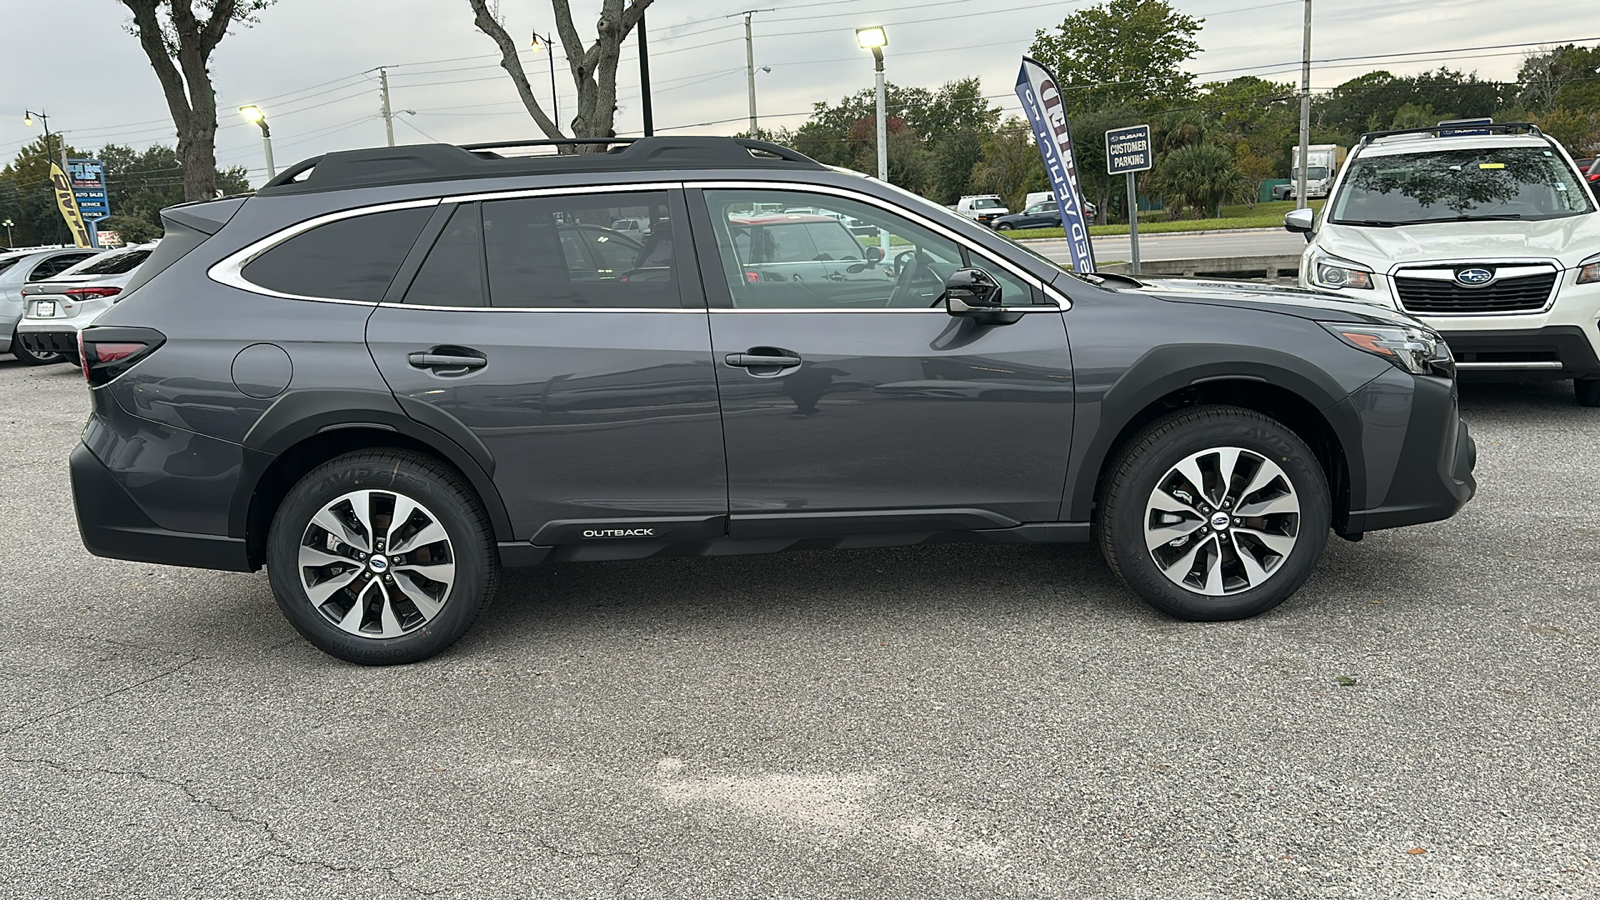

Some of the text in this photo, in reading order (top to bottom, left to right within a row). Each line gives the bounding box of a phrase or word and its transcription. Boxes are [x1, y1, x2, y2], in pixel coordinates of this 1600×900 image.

[1119, 132, 1146, 141] SUBARU
[1110, 140, 1147, 155] CUSTOMER
[1114, 153, 1145, 168] PARKING
[583, 528, 654, 537] OUTBACK
[330, 640, 411, 661] YOKOHAMA
